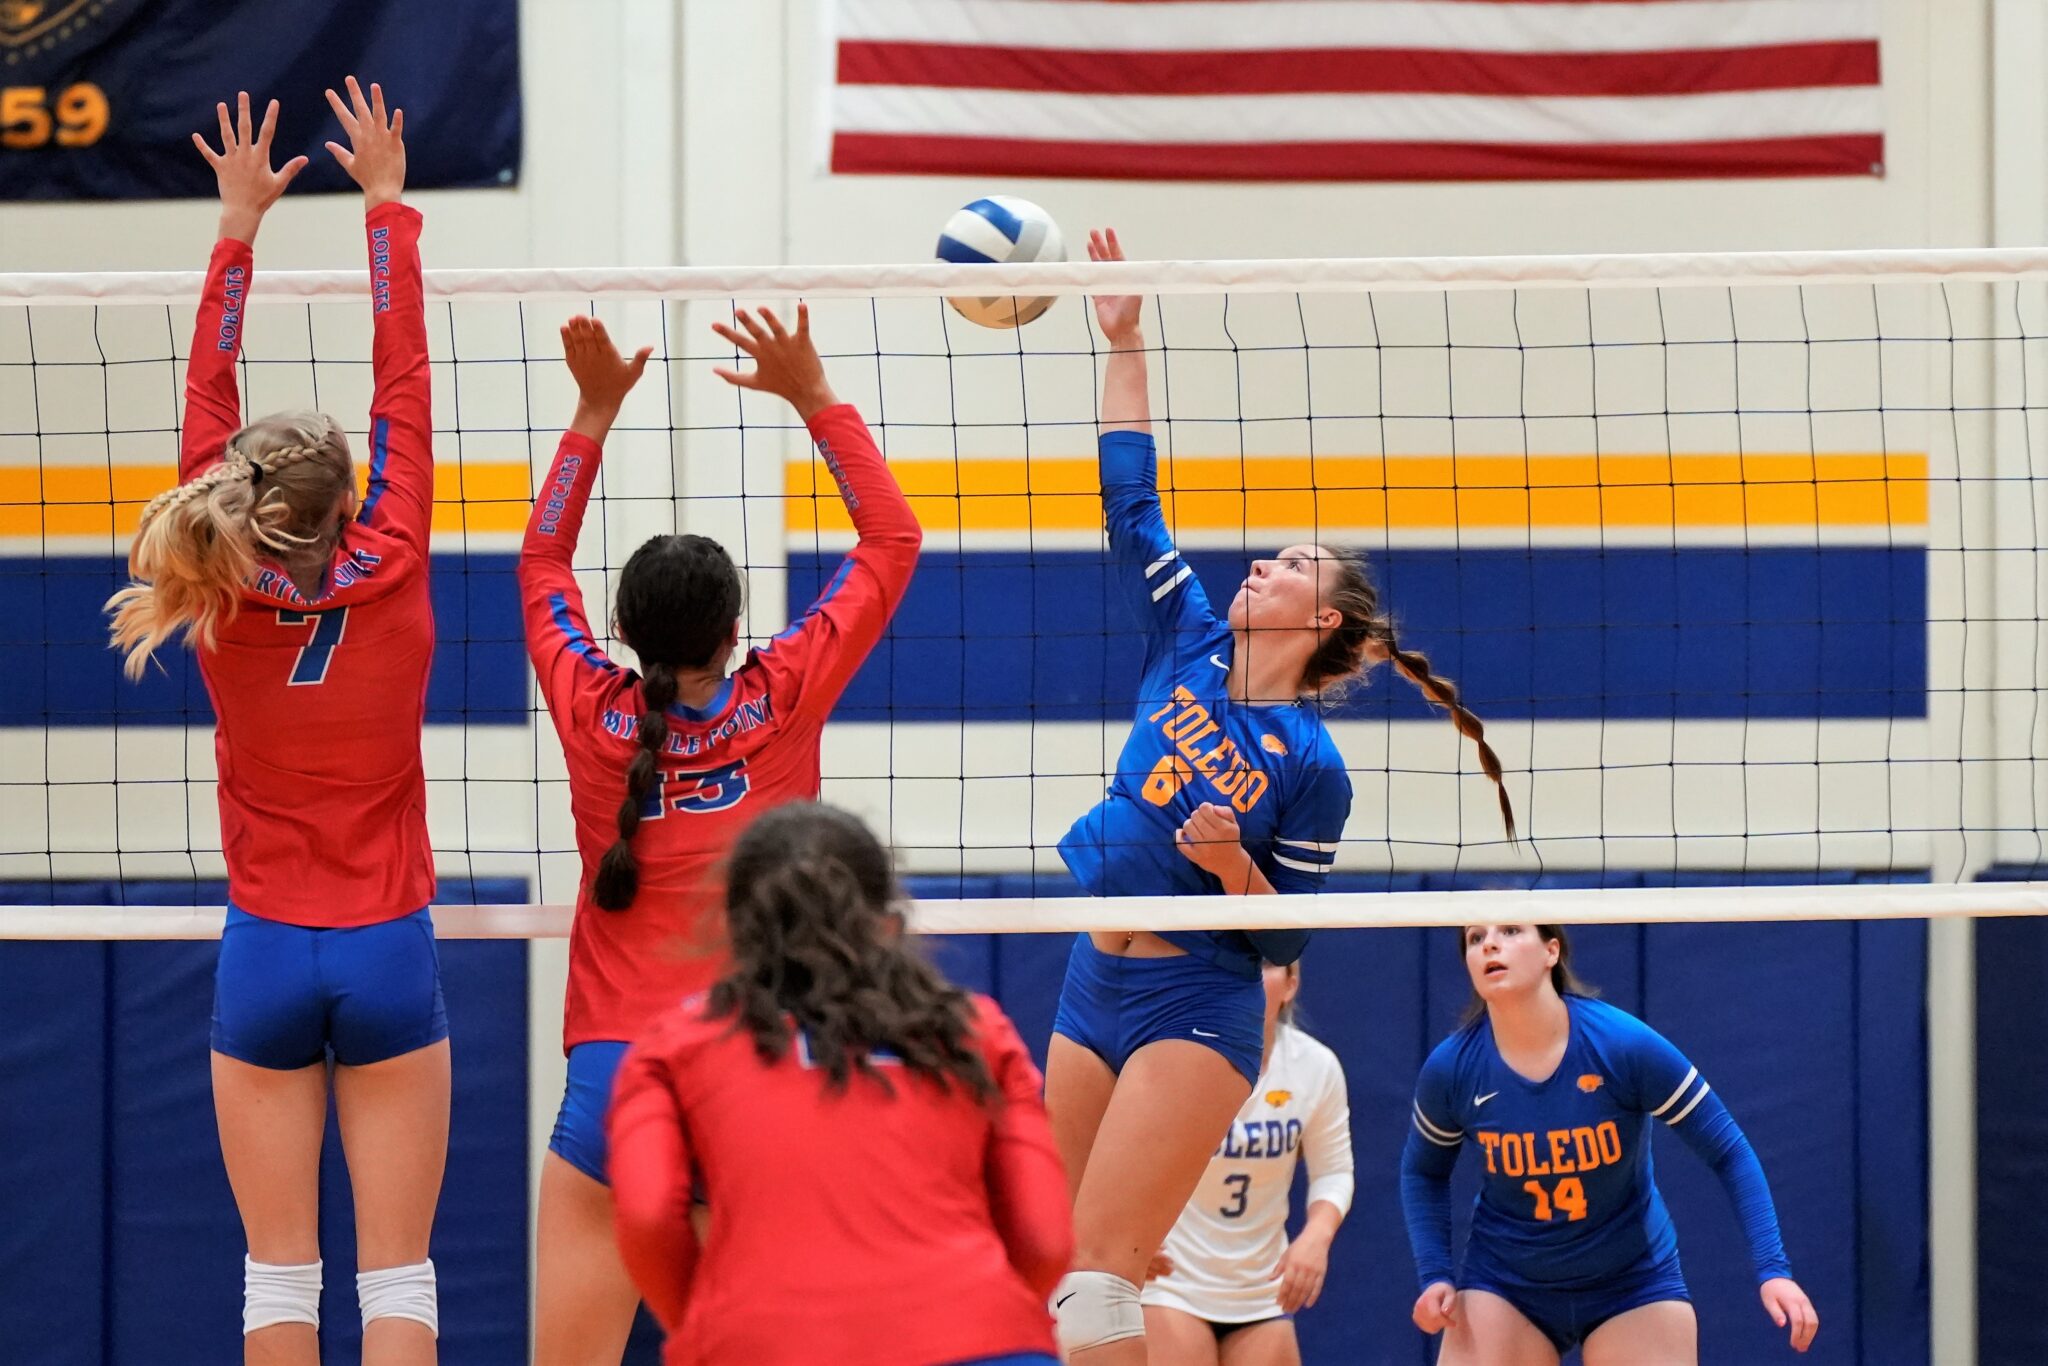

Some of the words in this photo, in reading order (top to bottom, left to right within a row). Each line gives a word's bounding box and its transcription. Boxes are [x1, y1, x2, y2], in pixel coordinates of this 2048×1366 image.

[0, 81, 109, 148] 59
[372, 226, 389, 313] BOBCATS
[218, 265, 245, 352] BOBCATS
[537, 454, 583, 536] BOBCATS
[276, 604, 350, 687] 7
[1141, 755, 1193, 807] 6
[1148, 684, 1270, 814] TOLEDO
[1214, 1118, 1302, 1159] LEDO
[1477, 1120, 1622, 1177] TOLEDO
[1219, 1174, 1251, 1218] 3
[1523, 1177, 1588, 1221] 14
